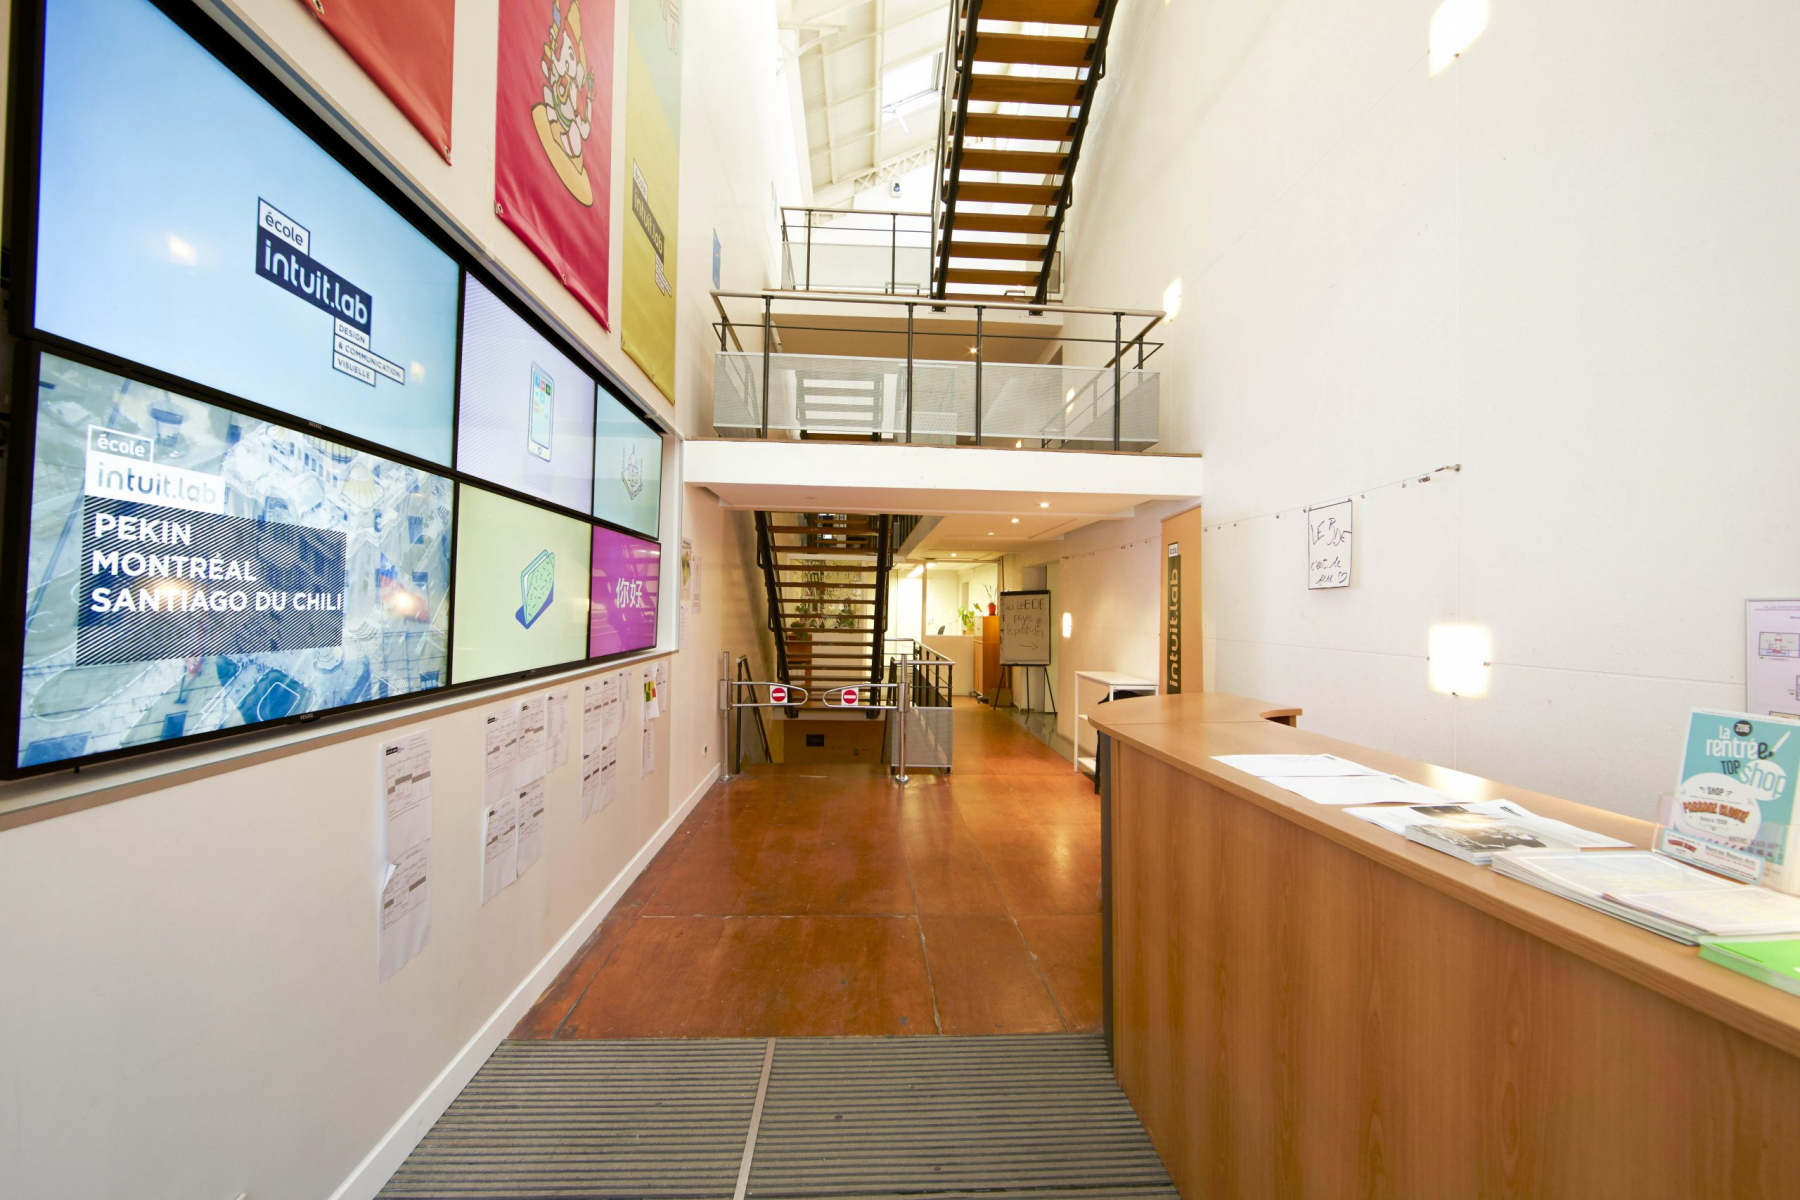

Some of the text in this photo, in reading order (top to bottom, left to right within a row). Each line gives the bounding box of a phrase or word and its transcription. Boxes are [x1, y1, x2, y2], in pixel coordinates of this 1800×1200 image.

[265, 212, 303, 246] école
[633, 189, 663, 255] intuit.lab
[264, 239, 368, 324] intuit.lab
[339, 324, 365, 344] DESIGN
[338, 358, 371, 380] VISUELLE
[345, 345, 400, 377] COMMUNICATION
[97, 434, 145, 457] école
[98, 462, 216, 505] intuit.lab
[94, 513, 191, 545] PEKIN
[92, 550, 257, 581] MONTRÉAL
[91, 588, 342, 612] SANTIAGO DU CHILI
[615, 577, 642, 608] 你好
[1169, 568, 1179, 687] intuit.lab
[1706, 738, 1769, 760] rentrée
[1720, 760, 1741, 775] TOP
[1739, 762, 1787, 799] shop
[1707, 786, 1724, 796] SHOP
[1683, 801, 1717, 814] PASSAGE
